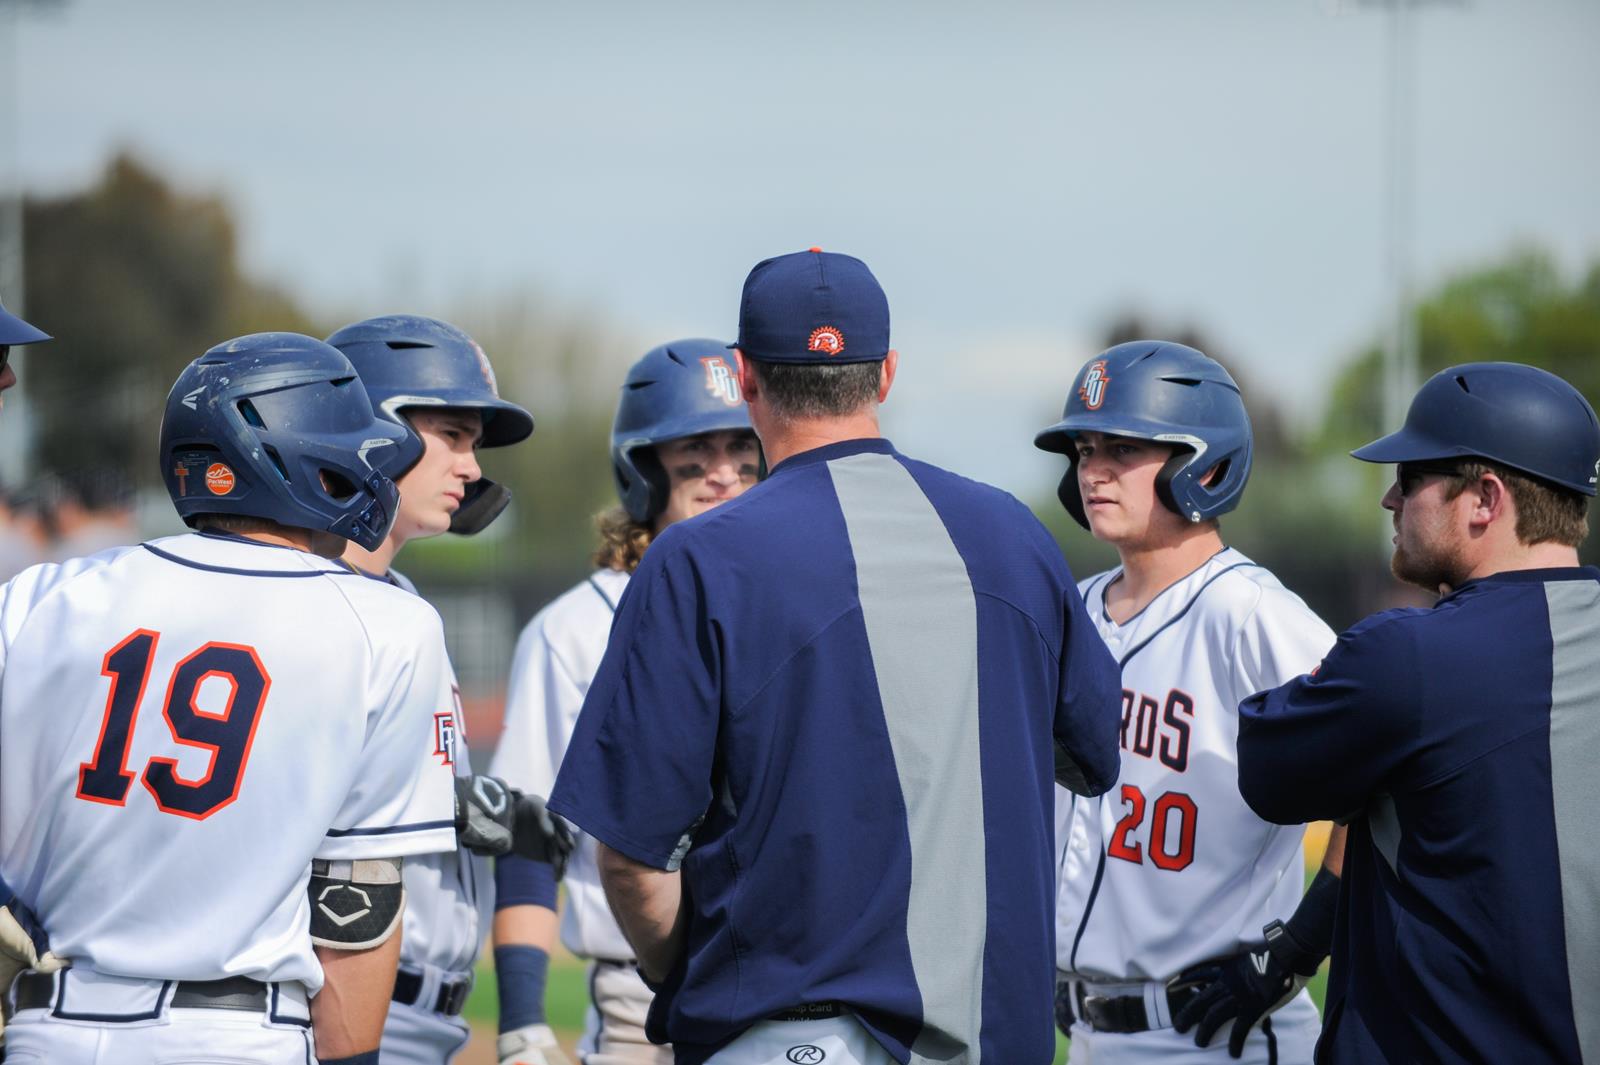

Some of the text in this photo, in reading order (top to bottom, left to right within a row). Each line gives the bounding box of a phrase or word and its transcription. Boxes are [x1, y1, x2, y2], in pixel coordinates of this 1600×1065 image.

[700, 356, 744, 407] FPU
[1078, 359, 1111, 411] FPU
[75, 628, 272, 821] 19
[1107, 783, 1199, 872] 20
[808, 1003, 833, 1012] Card
